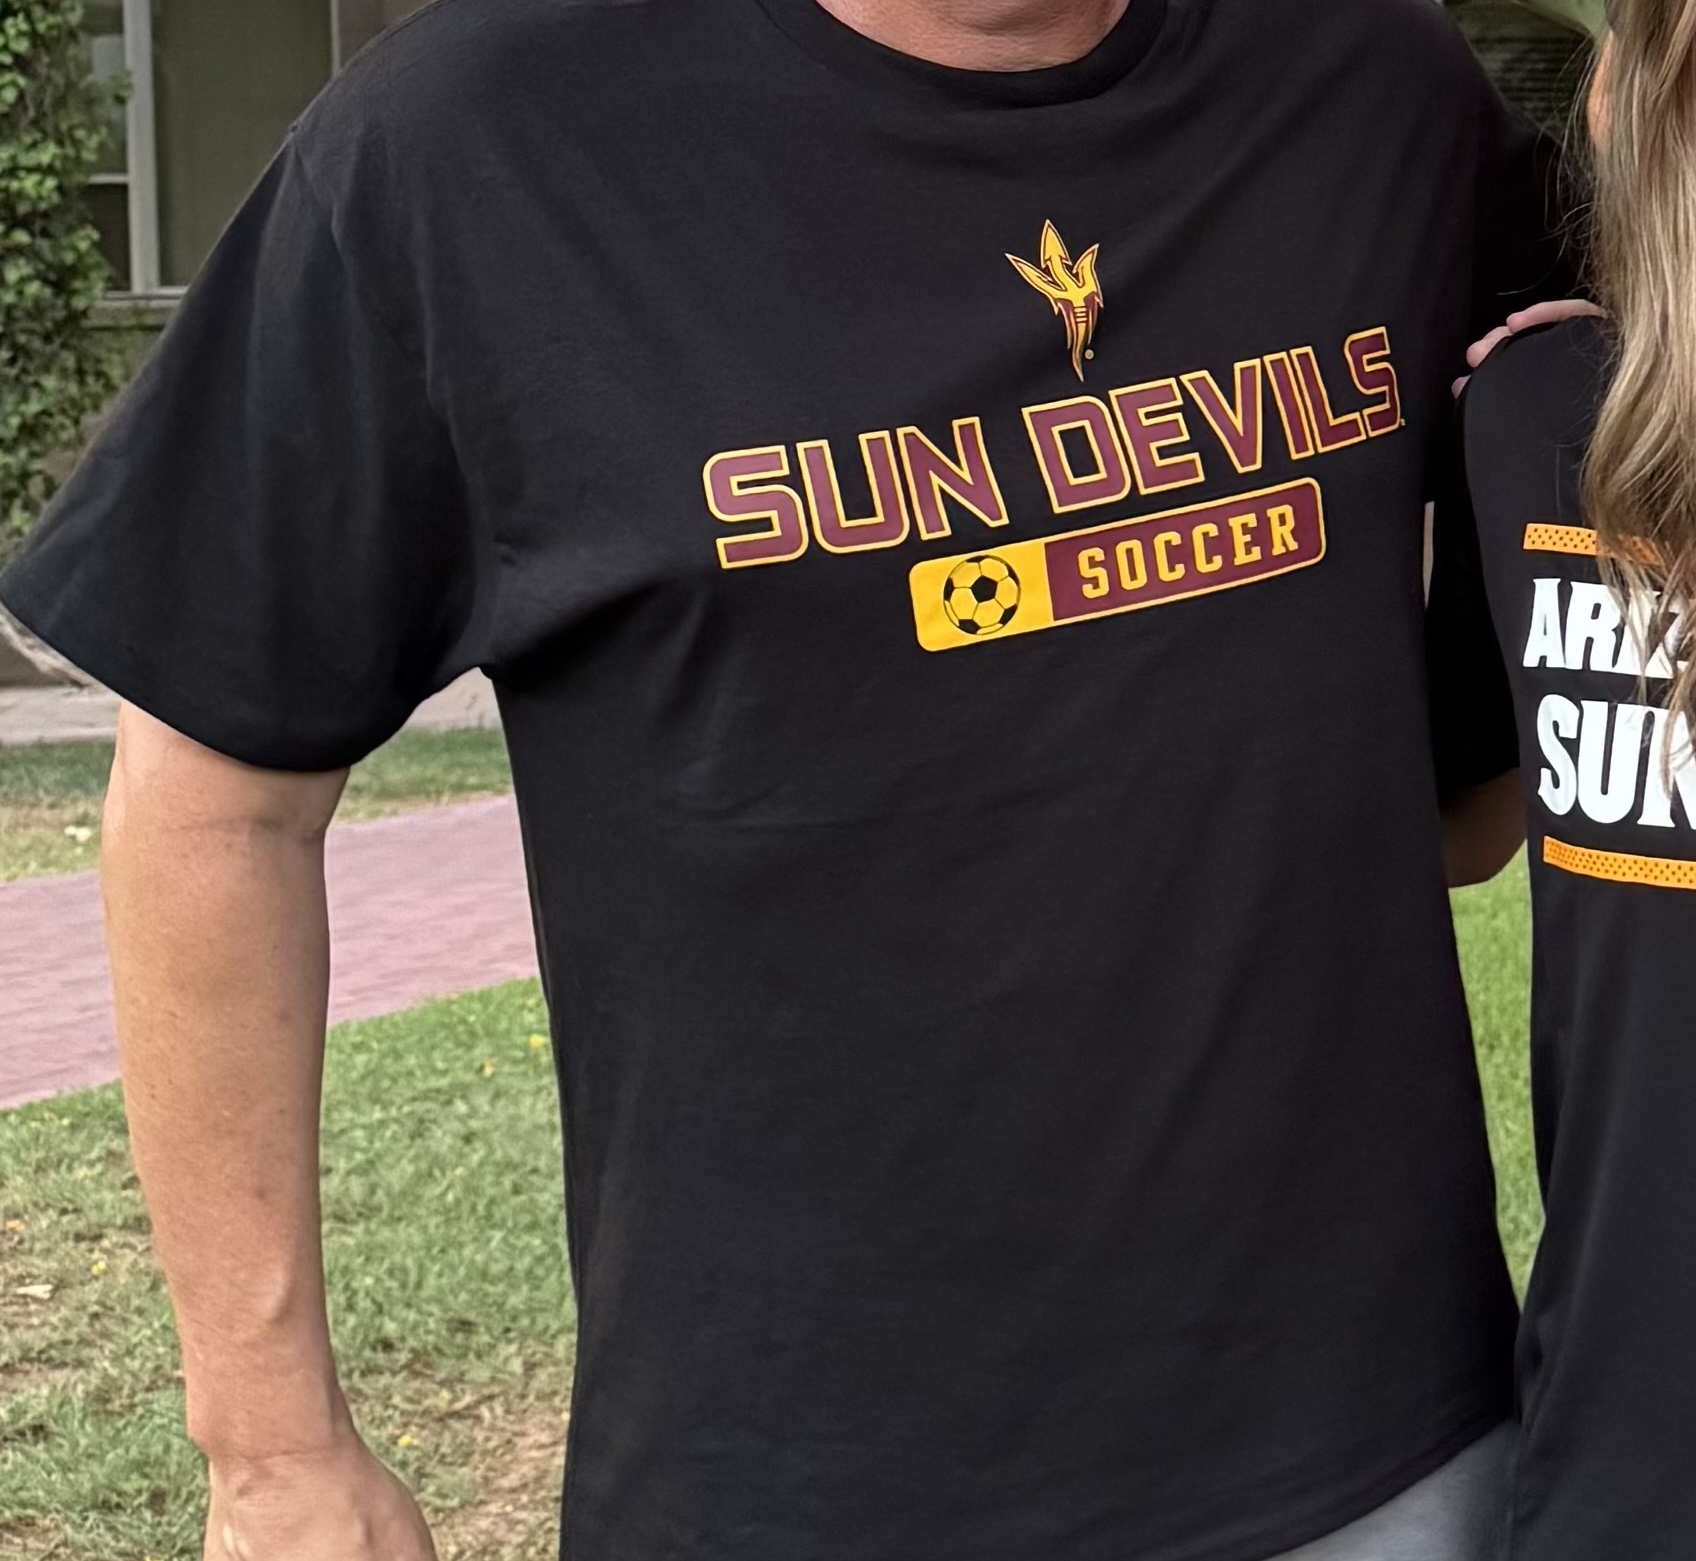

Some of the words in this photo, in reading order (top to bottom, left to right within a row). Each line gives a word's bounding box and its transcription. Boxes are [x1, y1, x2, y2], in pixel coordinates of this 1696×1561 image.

[702, 417, 1008, 569] SUN
[1022, 326, 1402, 515] DEVILS
[1077, 504, 1299, 600] SOCCER
